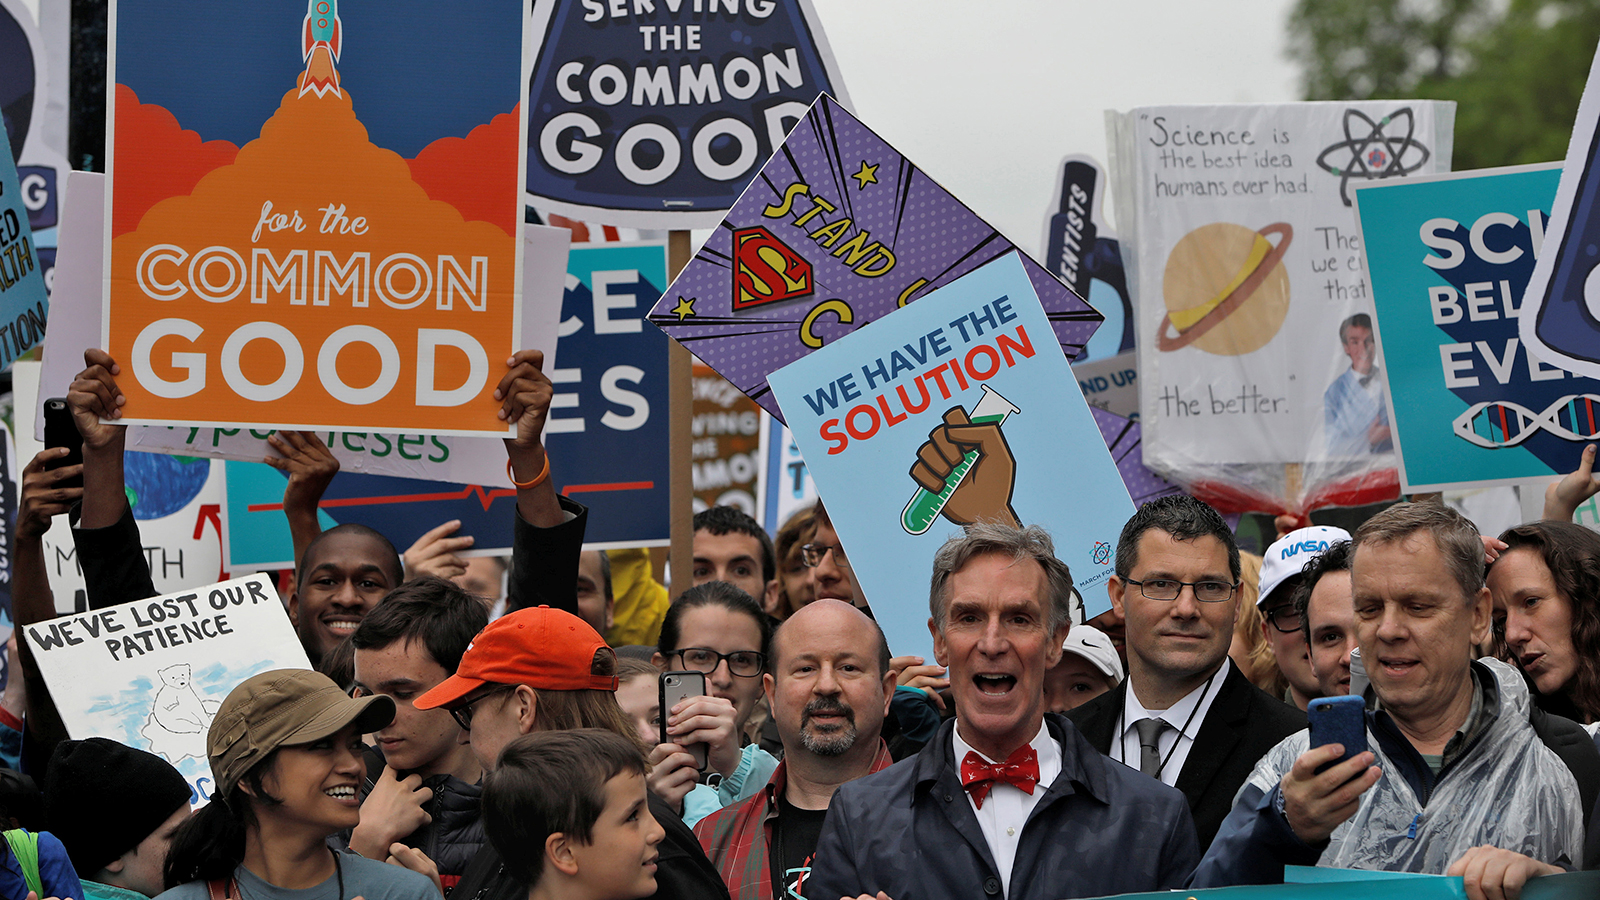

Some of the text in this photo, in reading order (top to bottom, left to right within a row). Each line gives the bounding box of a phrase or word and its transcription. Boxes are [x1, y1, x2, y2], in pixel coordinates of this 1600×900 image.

[640, 25, 701, 51] THE
[556, 48, 803, 106] COMMON
[1273, 129, 1290, 144] is
[1160, 149, 1293, 169] the best idea
[1155, 173, 1314, 197] humans ever had.
[252, 201, 369, 242] for the
[762, 182, 897, 278] STAND
[1314, 226, 1360, 250] The
[135, 244, 489, 312] COMMON
[1311, 257, 1338, 273] we
[1323, 278, 1366, 300] that
[131, 317, 490, 407] GOOD
[802, 294, 1017, 417] WE HAVE THE
[819, 324, 1036, 455] SOLUTION
[1110, 369, 1137, 387] UP
[1159, 386, 1200, 417] the
[1281, 540, 1330, 560] NASA
[1079, 573, 1102, 588] MARCH
[1101, 567, 1115, 577] FOR
[29, 610, 125, 651] WE'VE
[130, 594, 199, 628] LOST
[208, 581, 269, 609] OUR
[105, 614, 234, 661] PATIENCE
